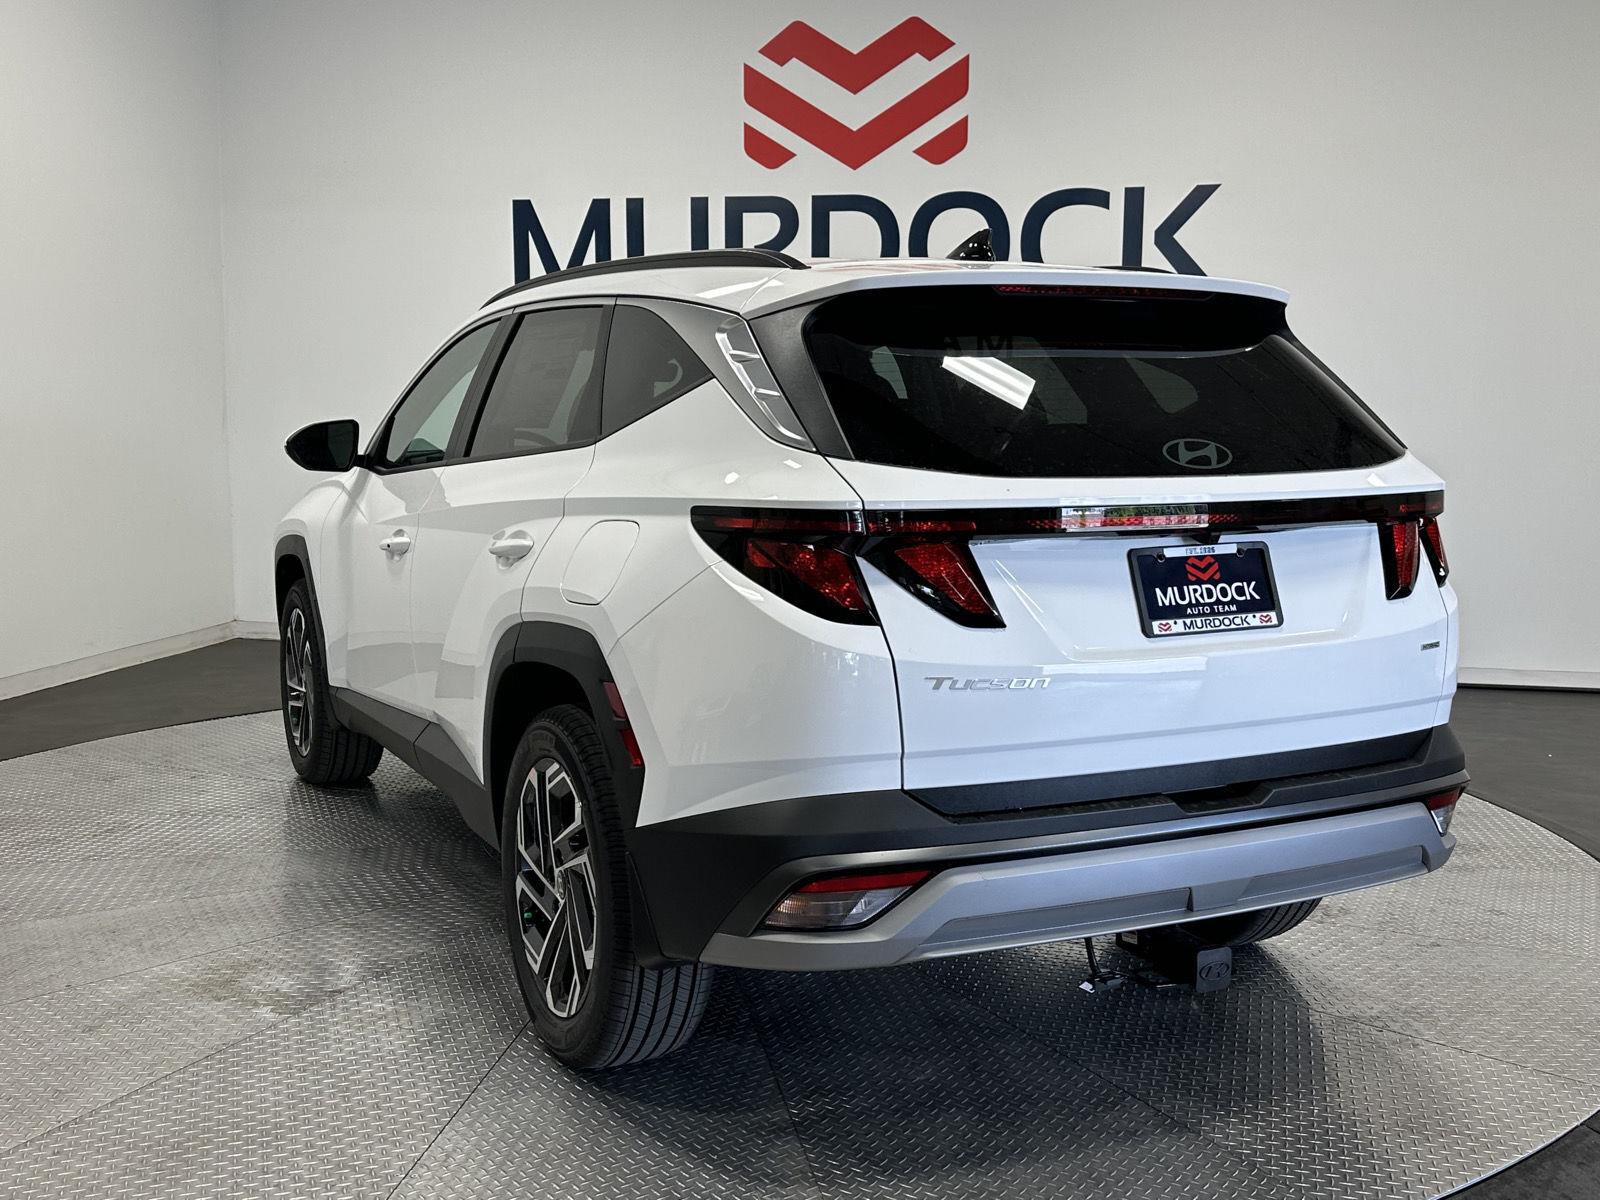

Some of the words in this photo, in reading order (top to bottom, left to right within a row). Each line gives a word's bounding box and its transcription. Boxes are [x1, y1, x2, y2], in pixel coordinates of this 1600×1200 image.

[1155, 581, 1260, 606] MURDOCK
[1187, 605, 1210, 615] AUTO
[1214, 604, 1237, 613] TEAM
[1183, 615, 1250, 631] MURDOCK
